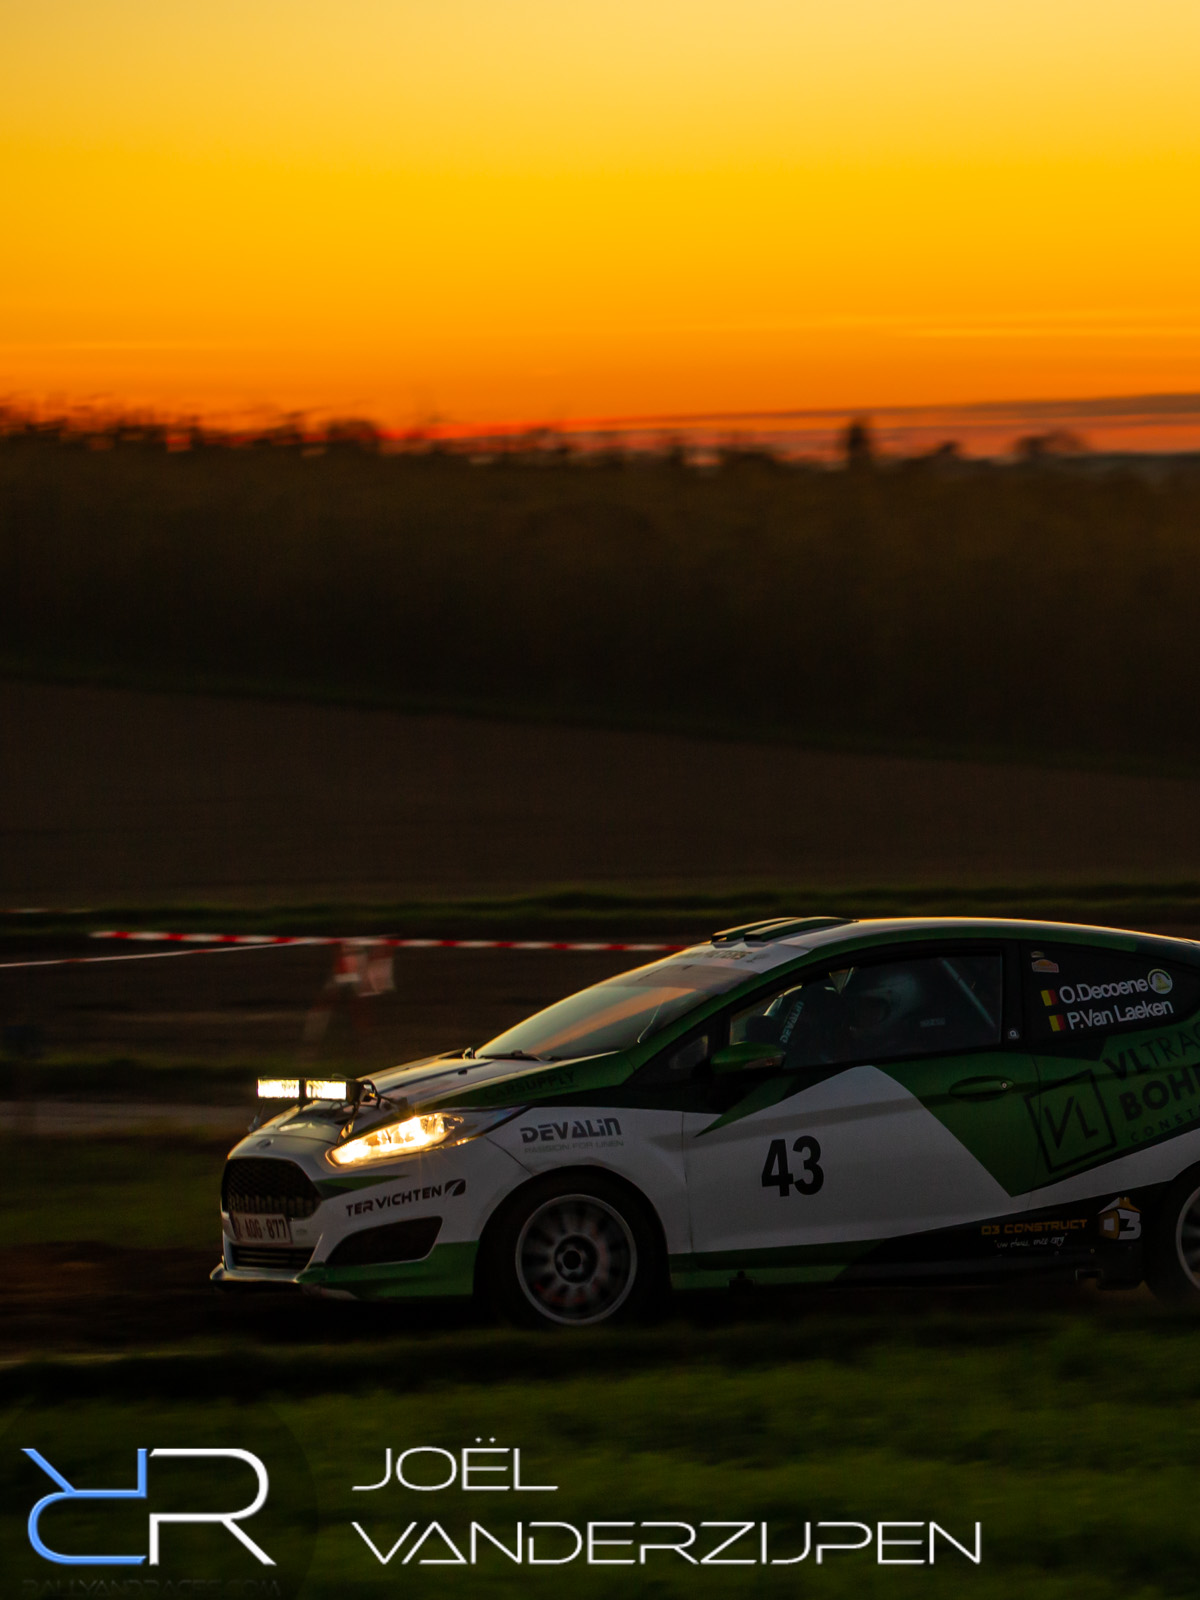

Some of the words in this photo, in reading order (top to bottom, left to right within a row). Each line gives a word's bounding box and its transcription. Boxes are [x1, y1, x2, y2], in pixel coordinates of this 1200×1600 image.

[1059, 978, 1148, 1004] O.Decoene
[1066, 1008, 1114, 1031] P.Van
[1114, 1000, 1174, 1023] Laeken
[1044, 1096, 1100, 1149] VL
[524, 1144, 570, 1154] PASSION
[572, 1142, 594, 1151] FOR
[596, 1140, 624, 1148] LINEN
[761, 1135, 824, 1197] 43
[345, 1200, 374, 1216] TER
[375, 1184, 442, 1209] VICHTEN
[1003, 1218, 1089, 1235] CONSTRUCT
